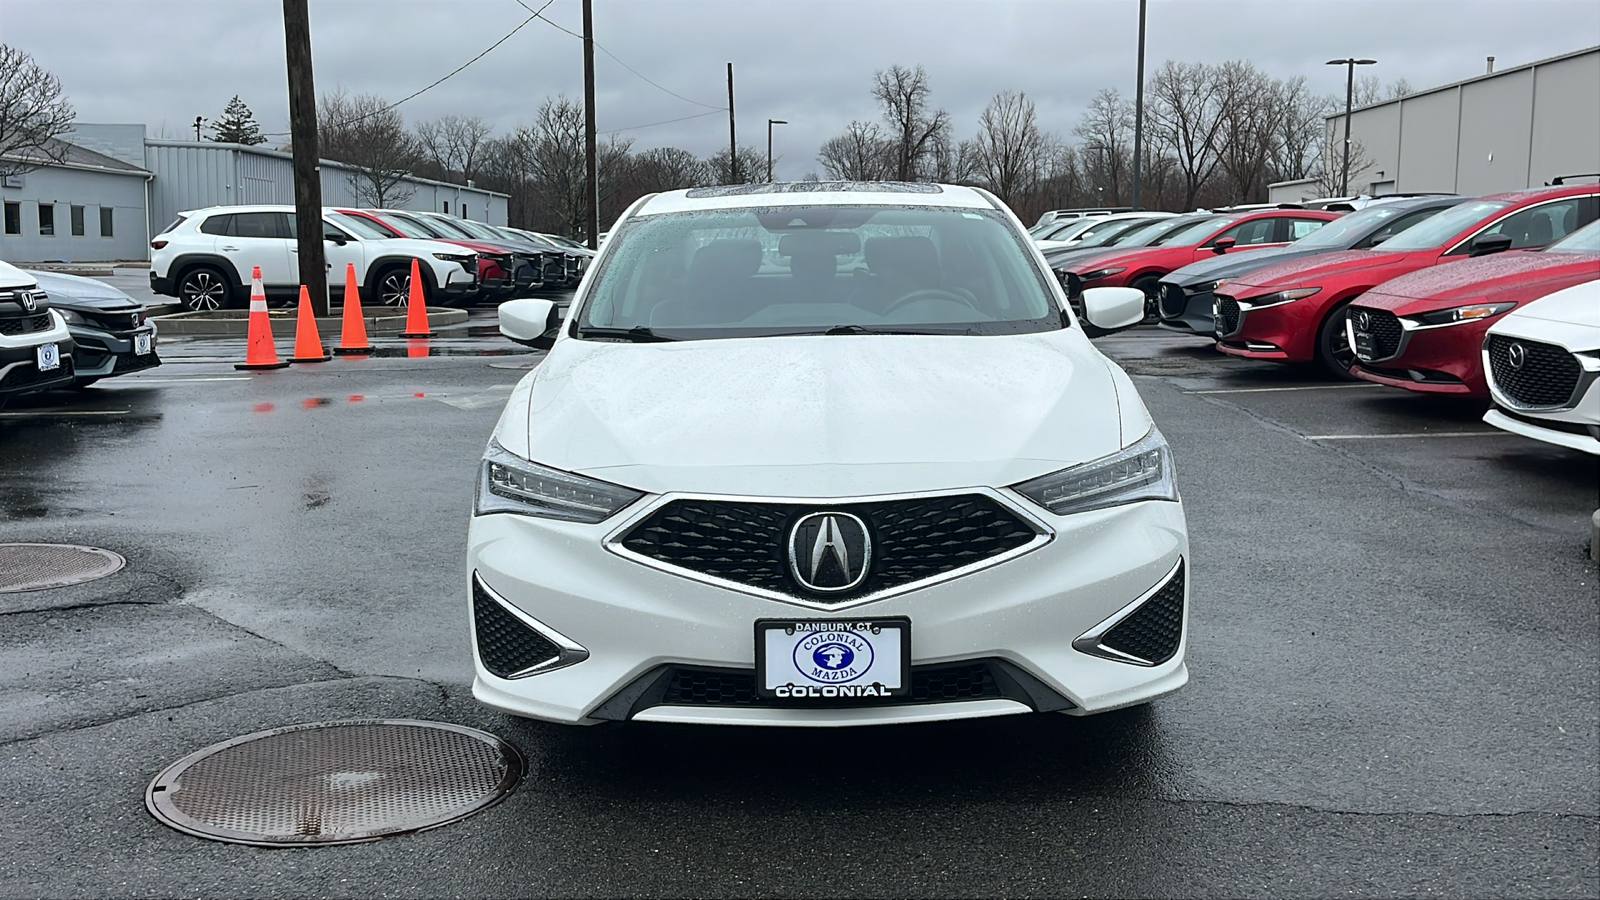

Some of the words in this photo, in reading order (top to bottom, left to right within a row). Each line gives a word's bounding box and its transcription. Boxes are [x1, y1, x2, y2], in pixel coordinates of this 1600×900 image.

[795, 622, 853, 632] DANBURY,
[856, 622, 873, 631] CT
[803, 633, 865, 652] COLONIAL
[811, 667, 858, 681] MAZDA
[775, 686, 892, 698] COLONIAL
